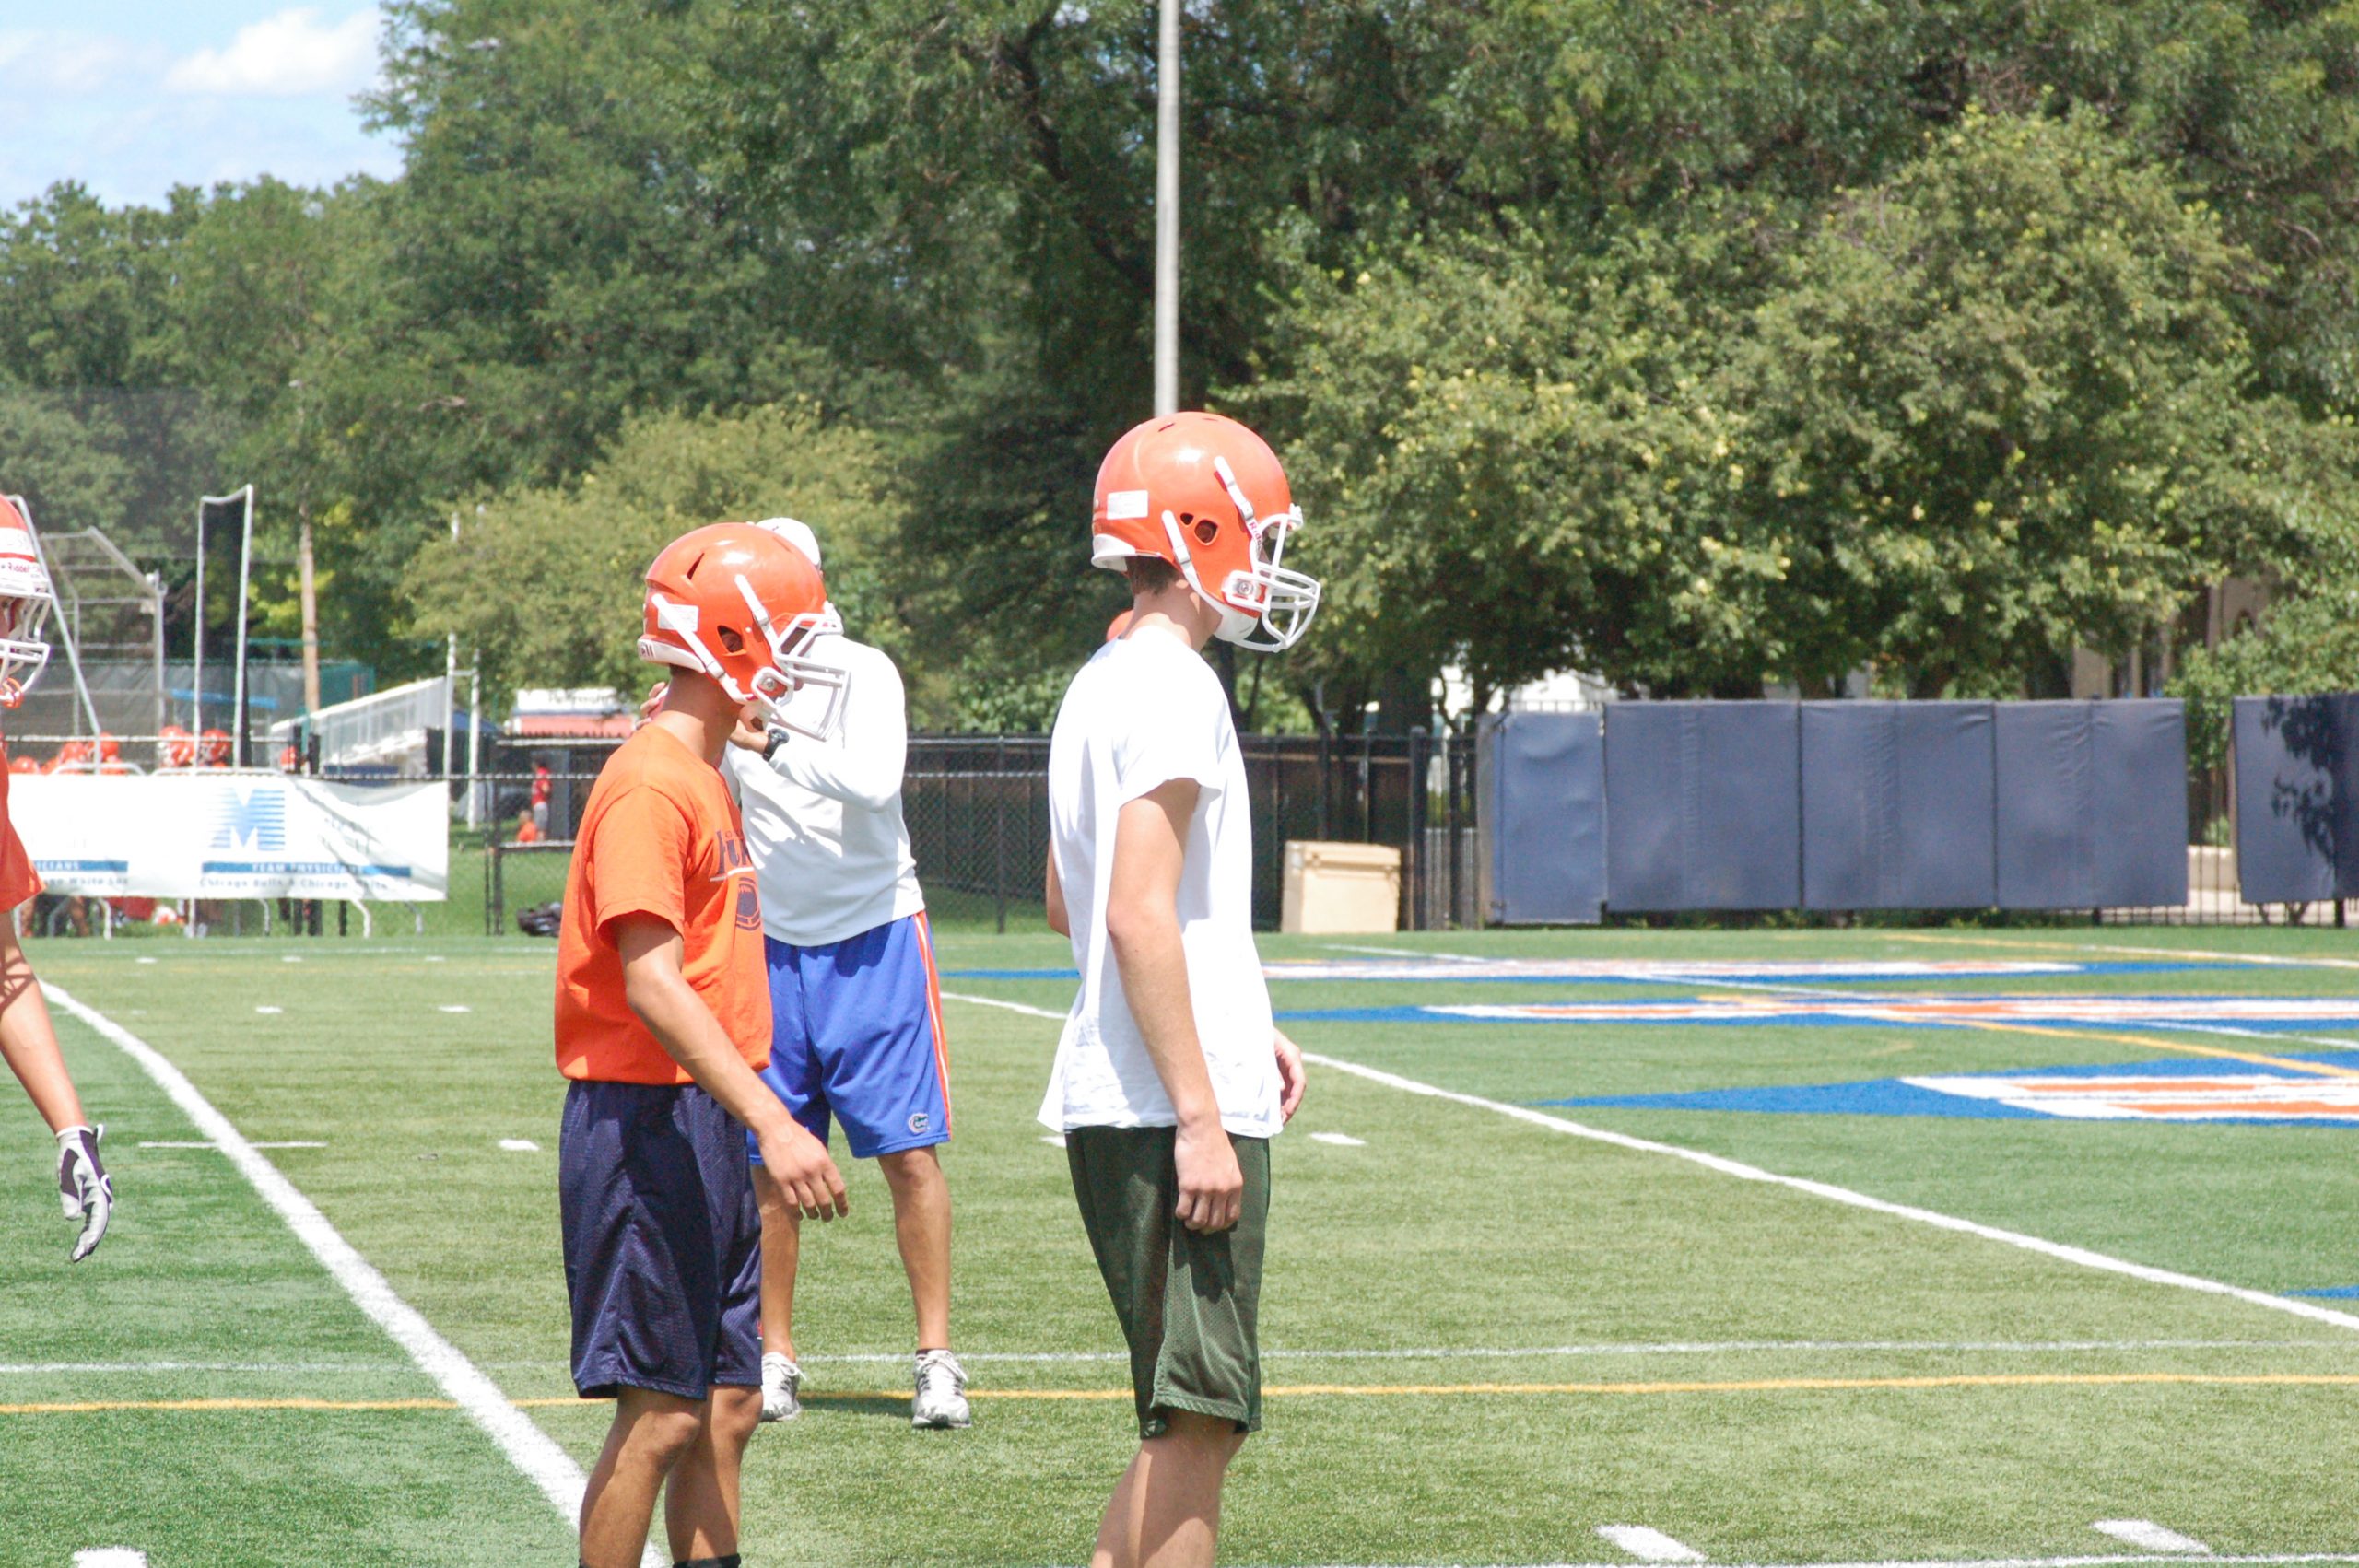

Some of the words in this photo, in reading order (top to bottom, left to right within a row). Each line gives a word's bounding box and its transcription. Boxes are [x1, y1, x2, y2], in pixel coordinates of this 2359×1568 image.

[252, 862, 286, 872] TEAM
[199, 877, 247, 888] Chicago
[300, 877, 349, 890] Chicago
